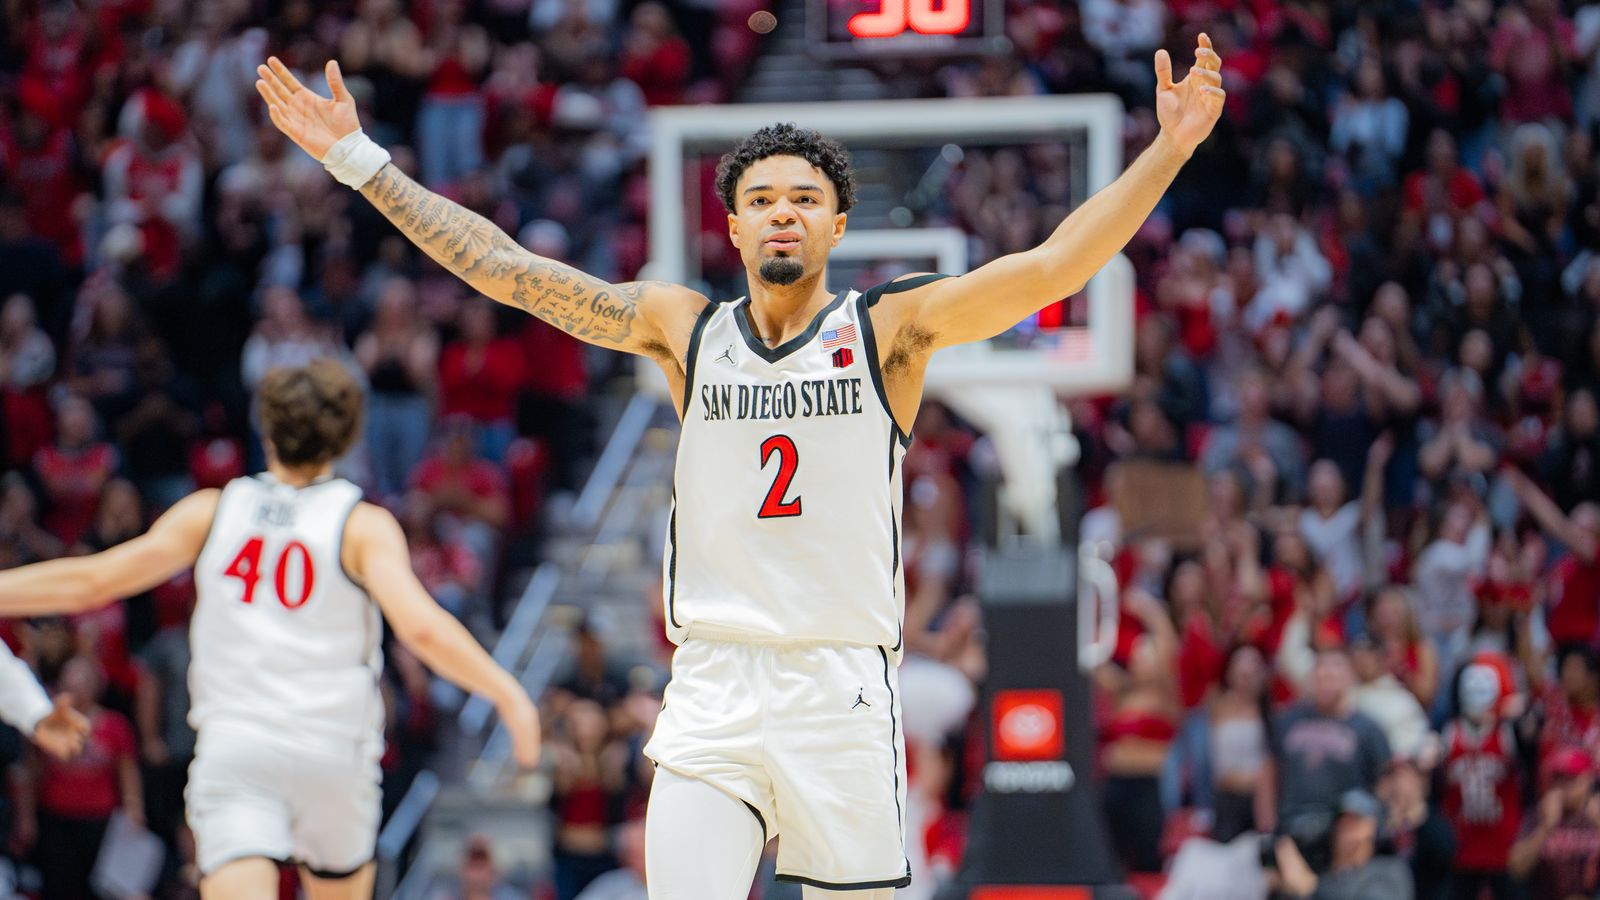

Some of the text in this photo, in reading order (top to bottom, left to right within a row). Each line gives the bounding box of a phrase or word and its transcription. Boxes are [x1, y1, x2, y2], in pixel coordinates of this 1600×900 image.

[528, 276, 630, 323] the grace of God
[550, 267, 586, 297] But by
[540, 307, 555, 316] am
[560, 312, 584, 324] what
[594, 325, 608, 333] am
[701, 378, 863, 421] SAN DIEGO STATE
[758, 434, 802, 519] 2
[223, 537, 315, 609] 40
